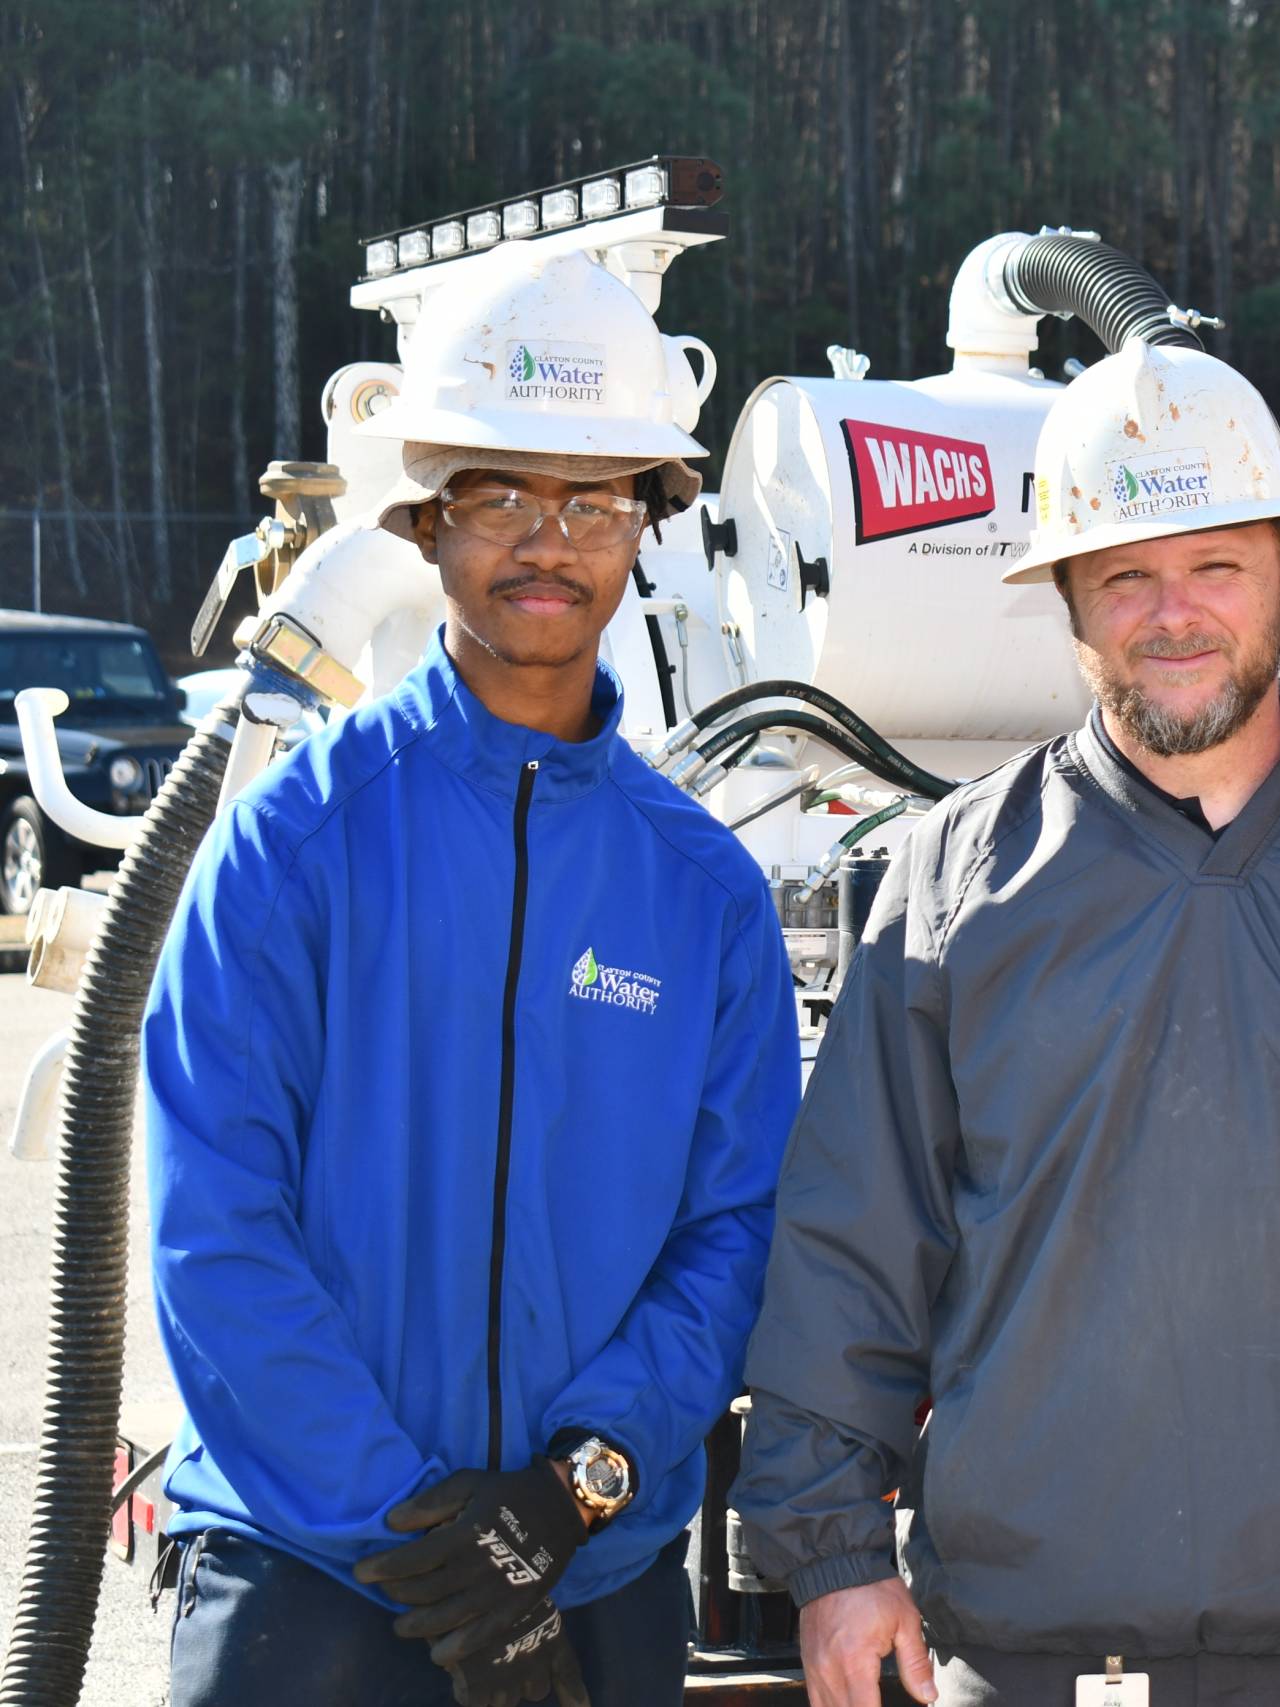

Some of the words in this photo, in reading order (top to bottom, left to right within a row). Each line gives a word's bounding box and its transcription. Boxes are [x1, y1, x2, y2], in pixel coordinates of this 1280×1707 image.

[534, 356, 570, 364] CLAYTON
[572, 357, 603, 366] COUNTY
[538, 363, 604, 385] Water
[509, 385, 603, 401] AUTHORITY
[864, 437, 987, 509] WACHS
[1140, 474, 1208, 497] Water
[1119, 492, 1211, 520] AUTHORITY
[908, 543, 918, 554] A
[922, 543, 972, 556] Division
[975, 544, 990, 556] of
[568, 983, 657, 1015] AUTHORITY
[599, 971, 660, 1002] Water
[477, 1528, 533, 1585] G-Tek
